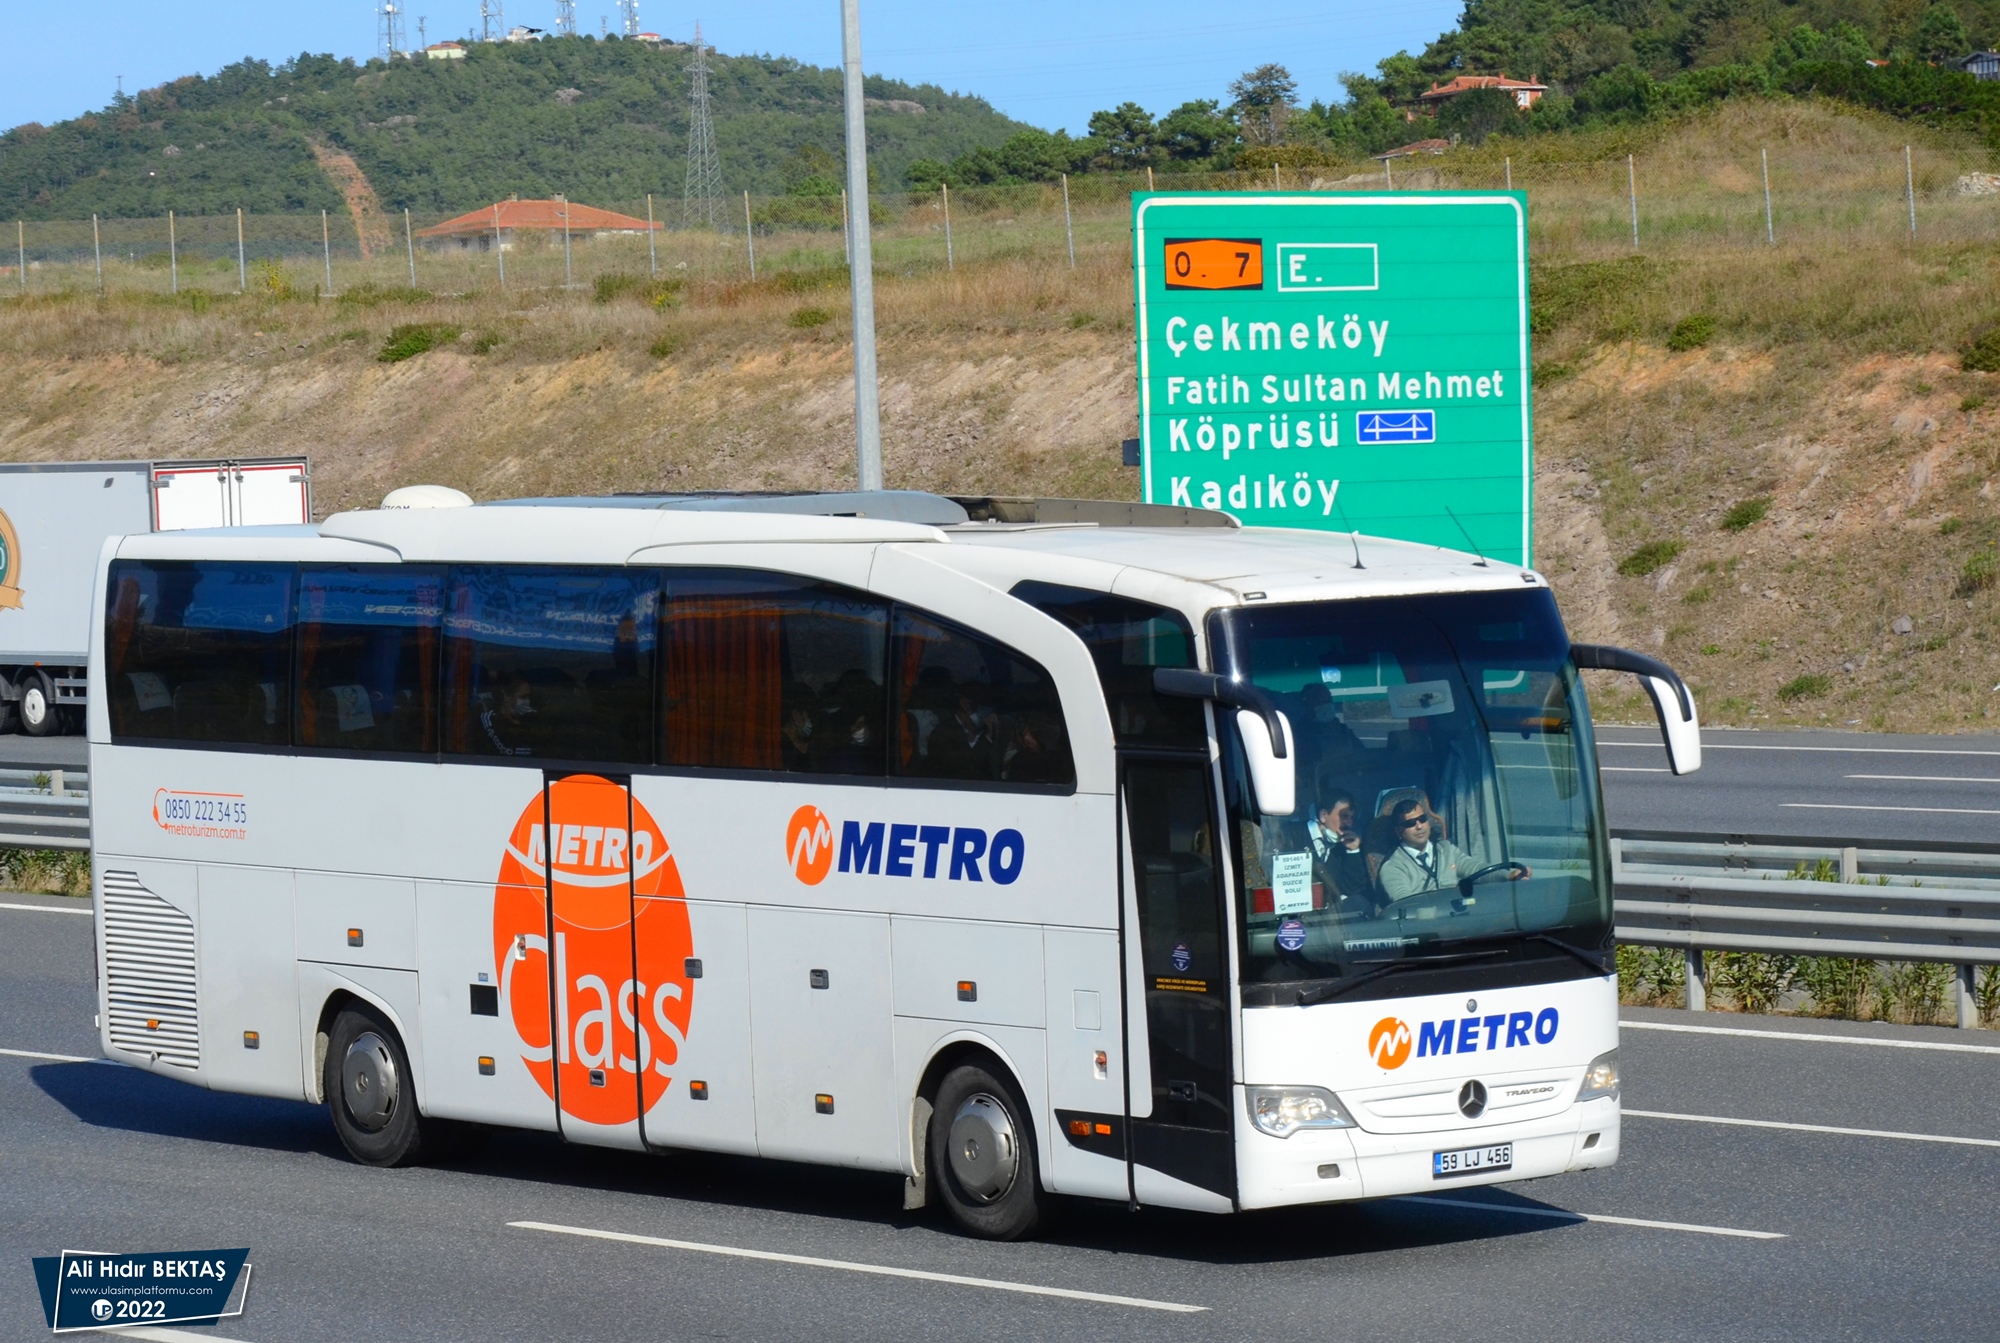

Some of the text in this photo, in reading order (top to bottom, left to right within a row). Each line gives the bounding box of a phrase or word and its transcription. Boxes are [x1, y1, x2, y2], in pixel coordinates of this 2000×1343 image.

[1235, 252, 1251, 278] 7
[1165, 314, 1389, 358] Çekmeköy
[1168, 371, 1504, 404] Fatih Sultan Mehmet
[1169, 413, 1339, 460] Köprüsü
[1171, 471, 1340, 516] Kadıköy
[165, 798, 247, 824] 0850 222 34 55
[167, 823, 247, 840] metroturizm.com.tr
[527, 823, 653, 870] METRO
[838, 820, 1025, 886] METRO
[500, 931, 687, 1079] Class
[1416, 1007, 1560, 1058] METRO
[1505, 1086, 1555, 1097] TRAVEGO
[1442, 1147, 1510, 1171] 59 LJ 456
